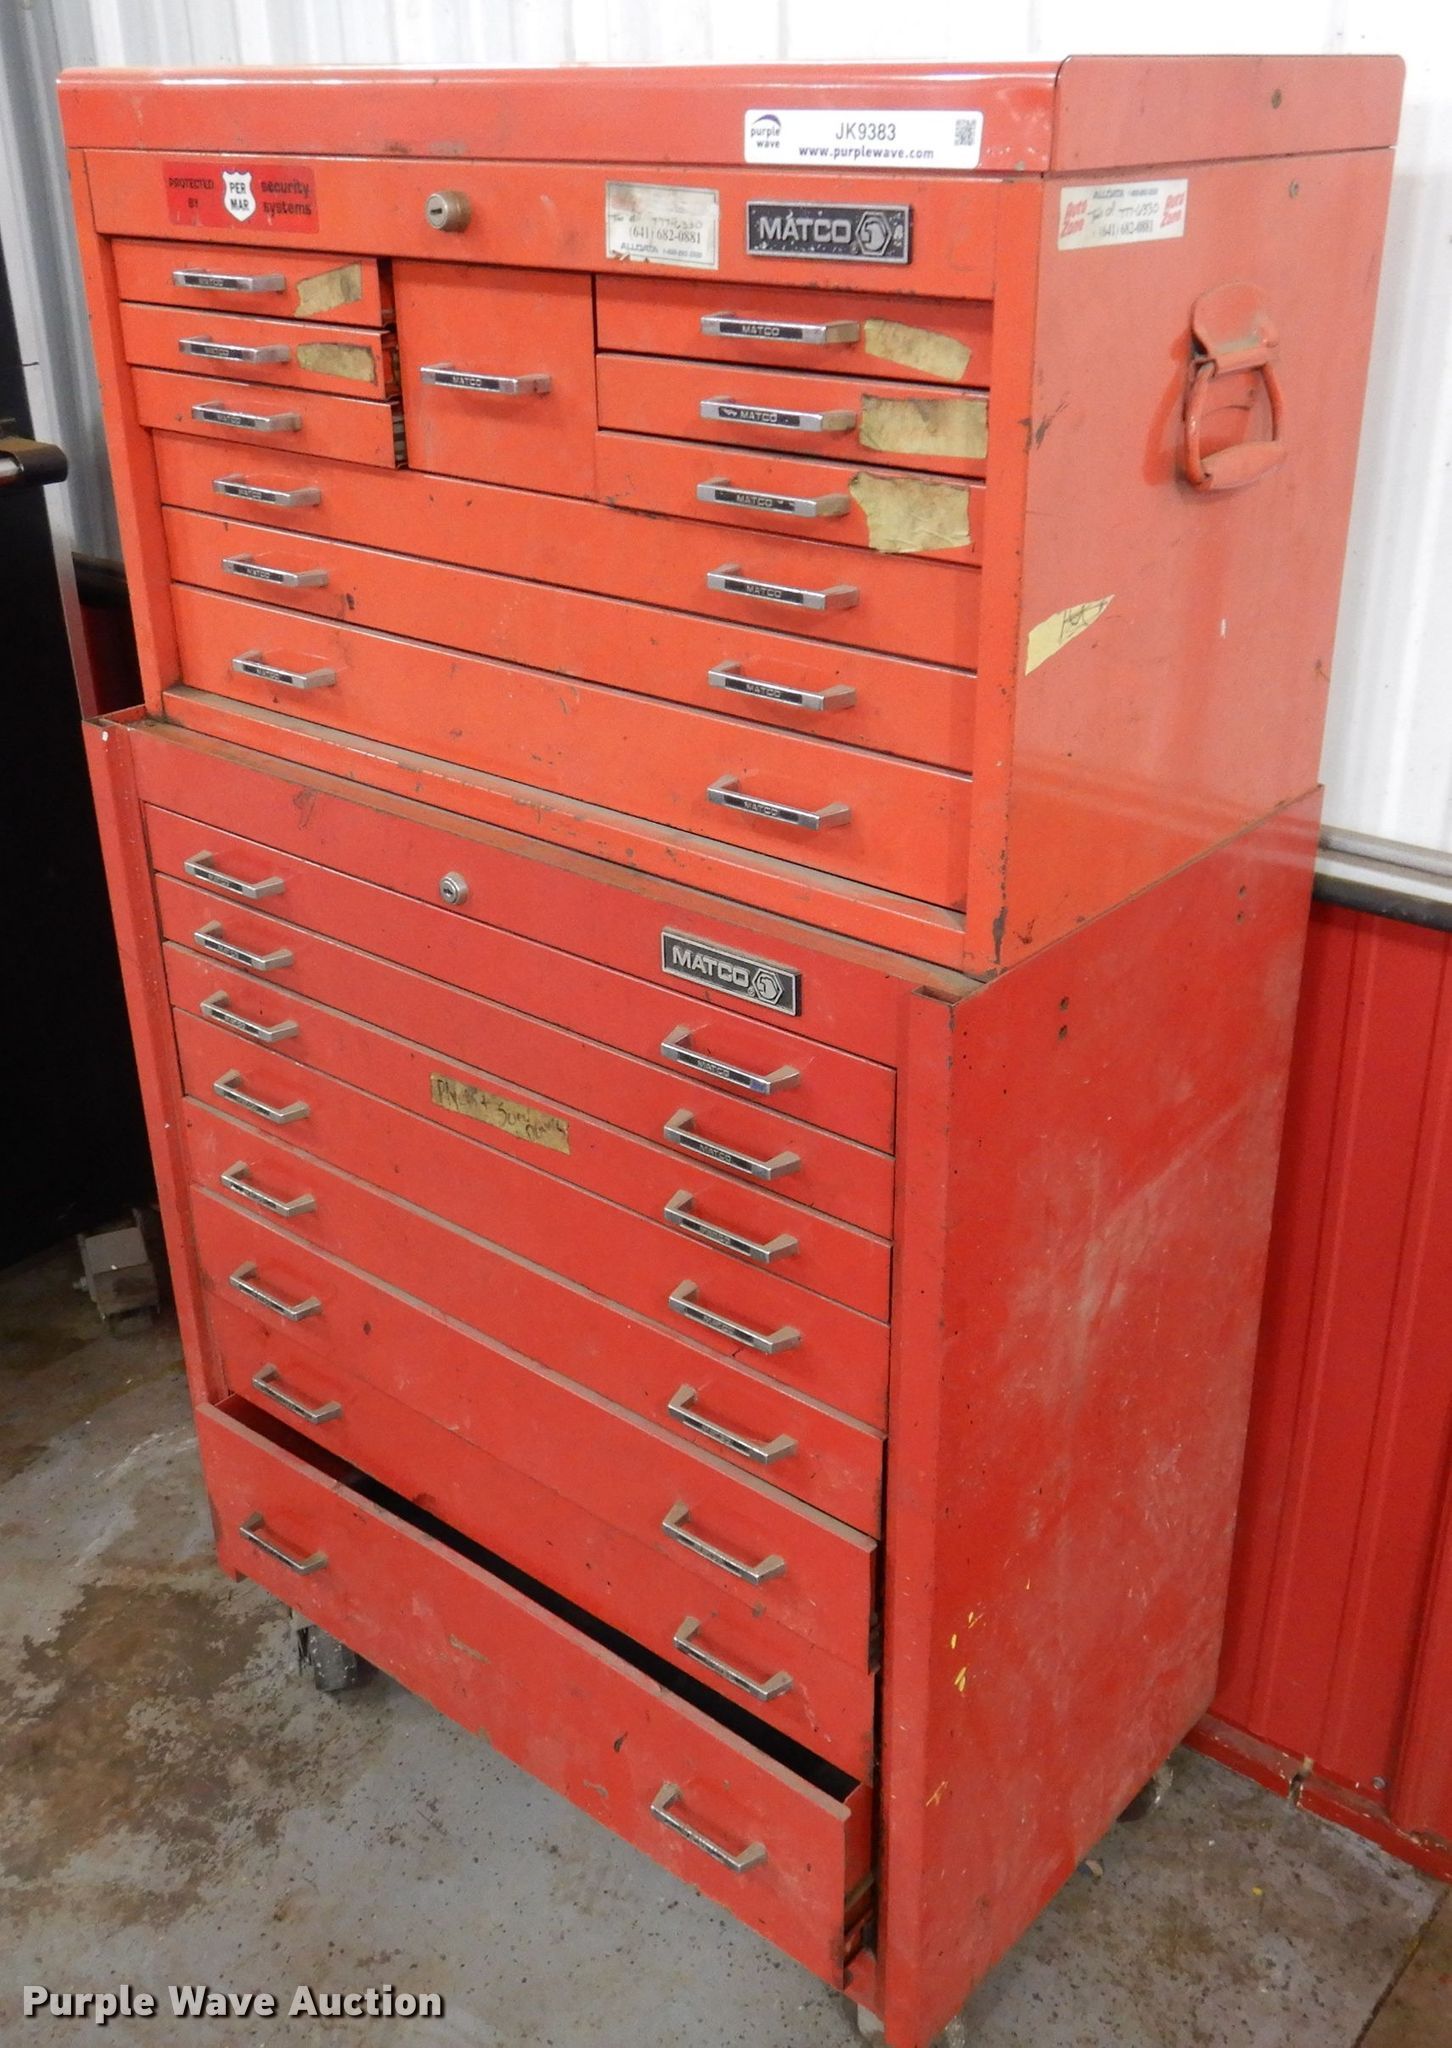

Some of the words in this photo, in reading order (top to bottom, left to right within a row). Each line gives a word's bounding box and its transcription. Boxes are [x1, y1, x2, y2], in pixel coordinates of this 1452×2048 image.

[750, 126, 781, 140] purple
[835, 122, 897, 141] JK9383
[756, 139, 780, 149] wave
[799, 145, 934, 160] www.purplewave.com
[168, 177, 215, 190] PROTECTED
[229, 182, 247, 194] PER
[260, 179, 310, 198] security
[230, 198, 249, 211] MAR
[263, 201, 312, 216] systems
[656, 228, 701, 244] 682-0881
[759, 215, 852, 244] MATCO
[741, 325, 780, 337] MATCO
[452, 376, 482, 387] MATCO
[739, 410, 778, 423] MATCO
[736, 494, 773, 508] MATCO
[746, 585, 782, 599] MATCO
[746, 684, 781, 698] MATCO
[744, 801, 779, 817] MATCO
[672, 945, 750, 988] MATCO
[697, 1060, 730, 1077] MATCO
